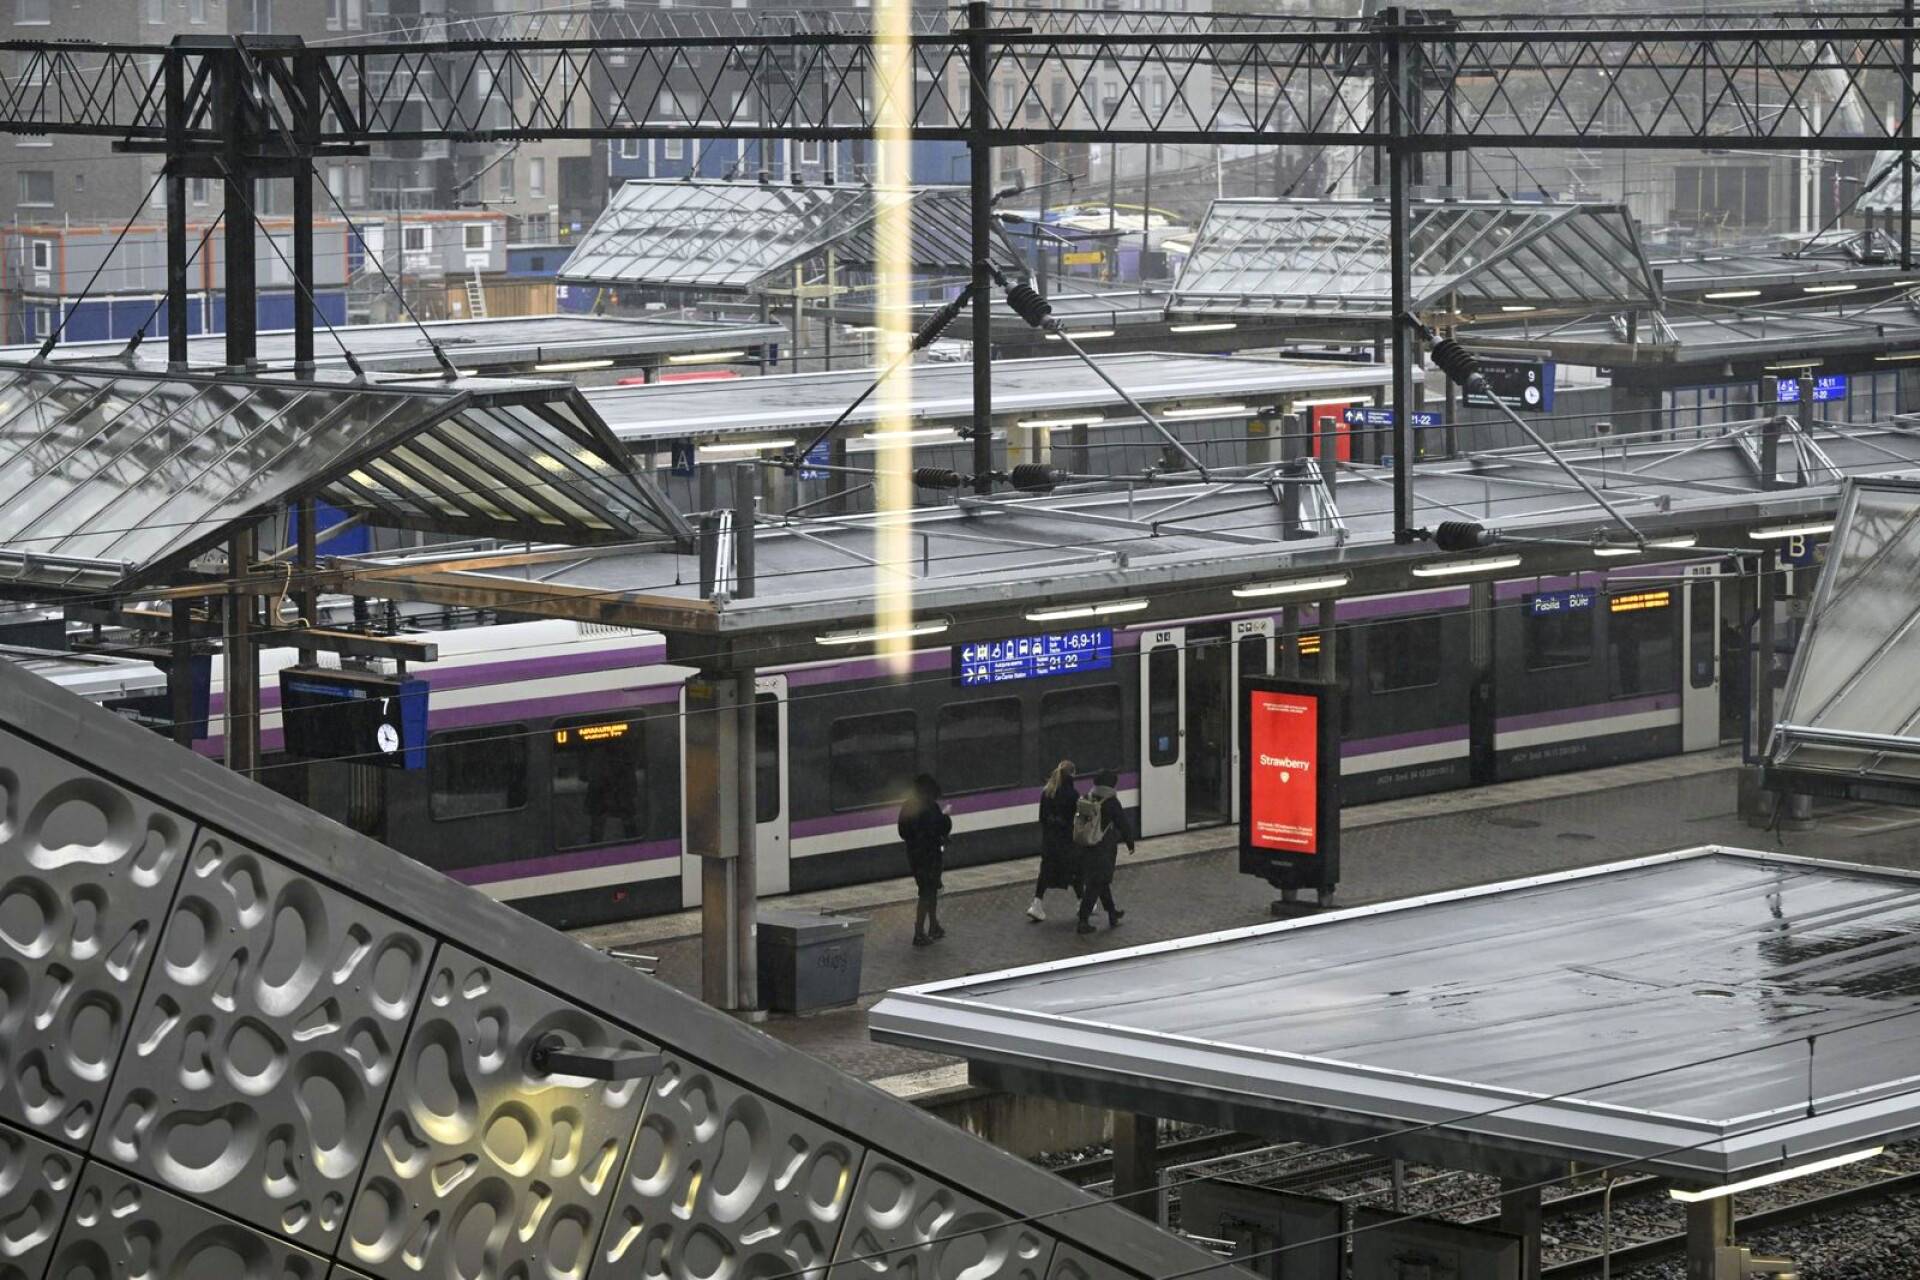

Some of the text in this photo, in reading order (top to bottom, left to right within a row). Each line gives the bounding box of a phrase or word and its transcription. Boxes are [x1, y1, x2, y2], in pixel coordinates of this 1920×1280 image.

[1528, 370, 1535, 382] 9
[676, 450, 690, 471] A
[1790, 535, 1805, 557] B
[1535, 596, 1560, 611] Pasila
[1063, 631, 1102, 649] 1-6,9-11
[1049, 654, 1078, 671] 2122
[381, 698, 390, 715] 7
[557, 730, 567, 743] U
[1260, 753, 1310, 771] Strawberry
